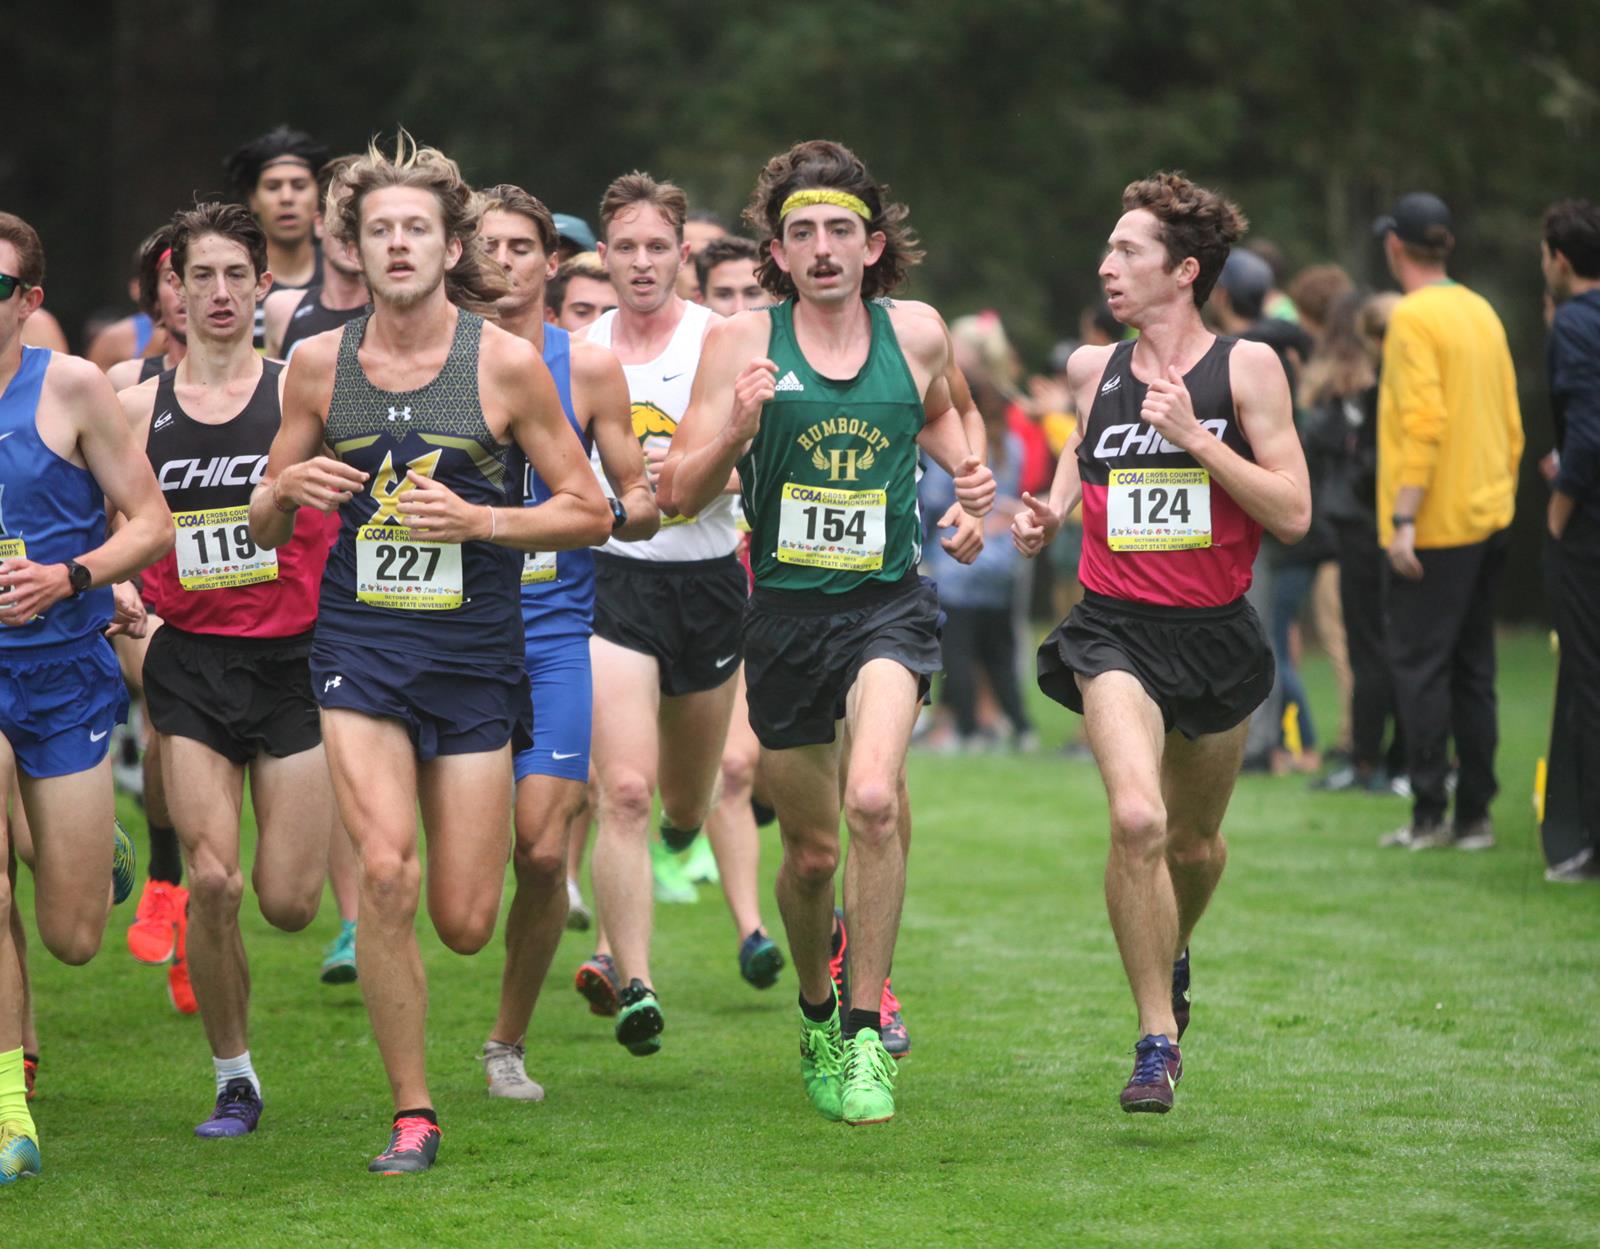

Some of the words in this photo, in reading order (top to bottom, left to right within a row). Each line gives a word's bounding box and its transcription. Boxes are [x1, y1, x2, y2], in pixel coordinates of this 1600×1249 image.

[776, 382, 804, 392] adidas
[797, 417, 890, 451] HUMBOLDT
[827, 449, 860, 481] H
[1117, 473, 1144, 484] CCAA
[791, 488, 821, 501] CCAA
[1128, 488, 1191, 524] 124
[178, 514, 205, 527] CCAA
[206, 516, 248, 524] CHAMPIONS
[803, 506, 866, 544] 154
[364, 528, 394, 540] CCAA
[192, 524, 256, 564] 119
[376, 544, 441, 582] 227
[238, 575, 270, 584] UNIVERSITY
